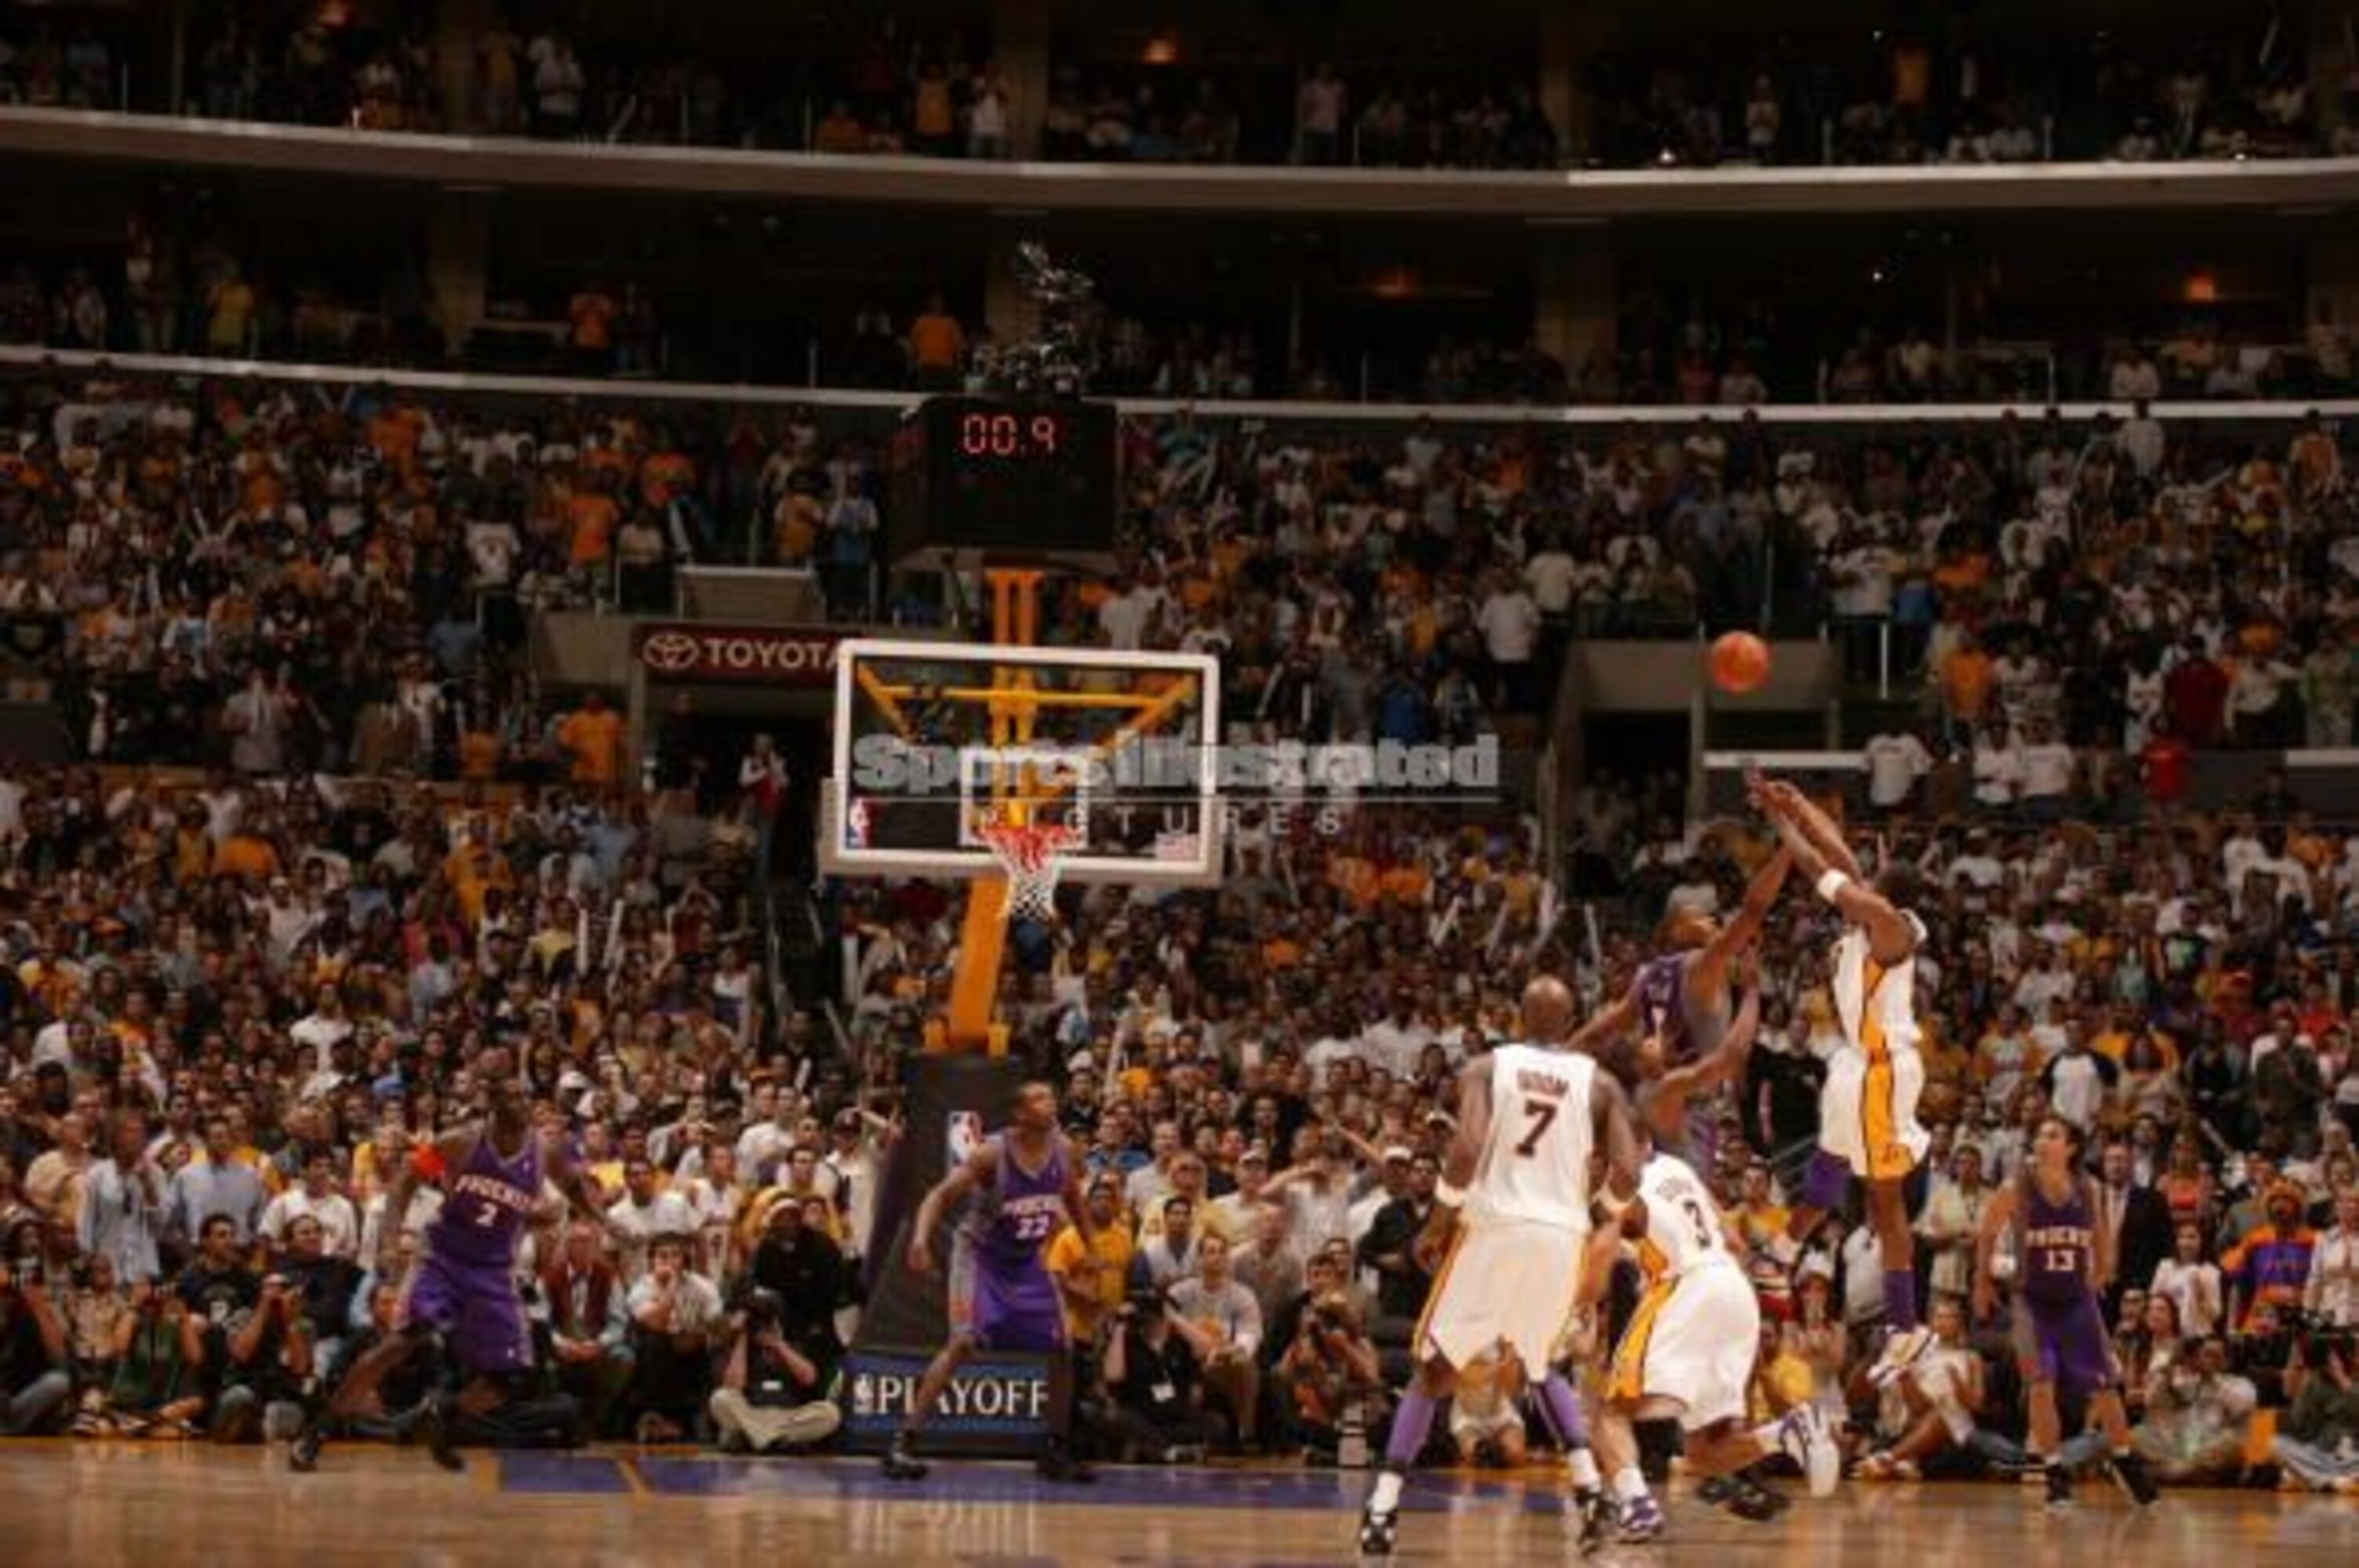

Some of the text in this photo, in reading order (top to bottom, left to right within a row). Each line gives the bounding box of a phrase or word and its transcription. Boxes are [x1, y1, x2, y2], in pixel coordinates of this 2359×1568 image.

[1514, 1099, 1558, 1158] 7
[475, 1202, 497, 1227] 2
[877, 1376, 1050, 1417] PLYOFF
